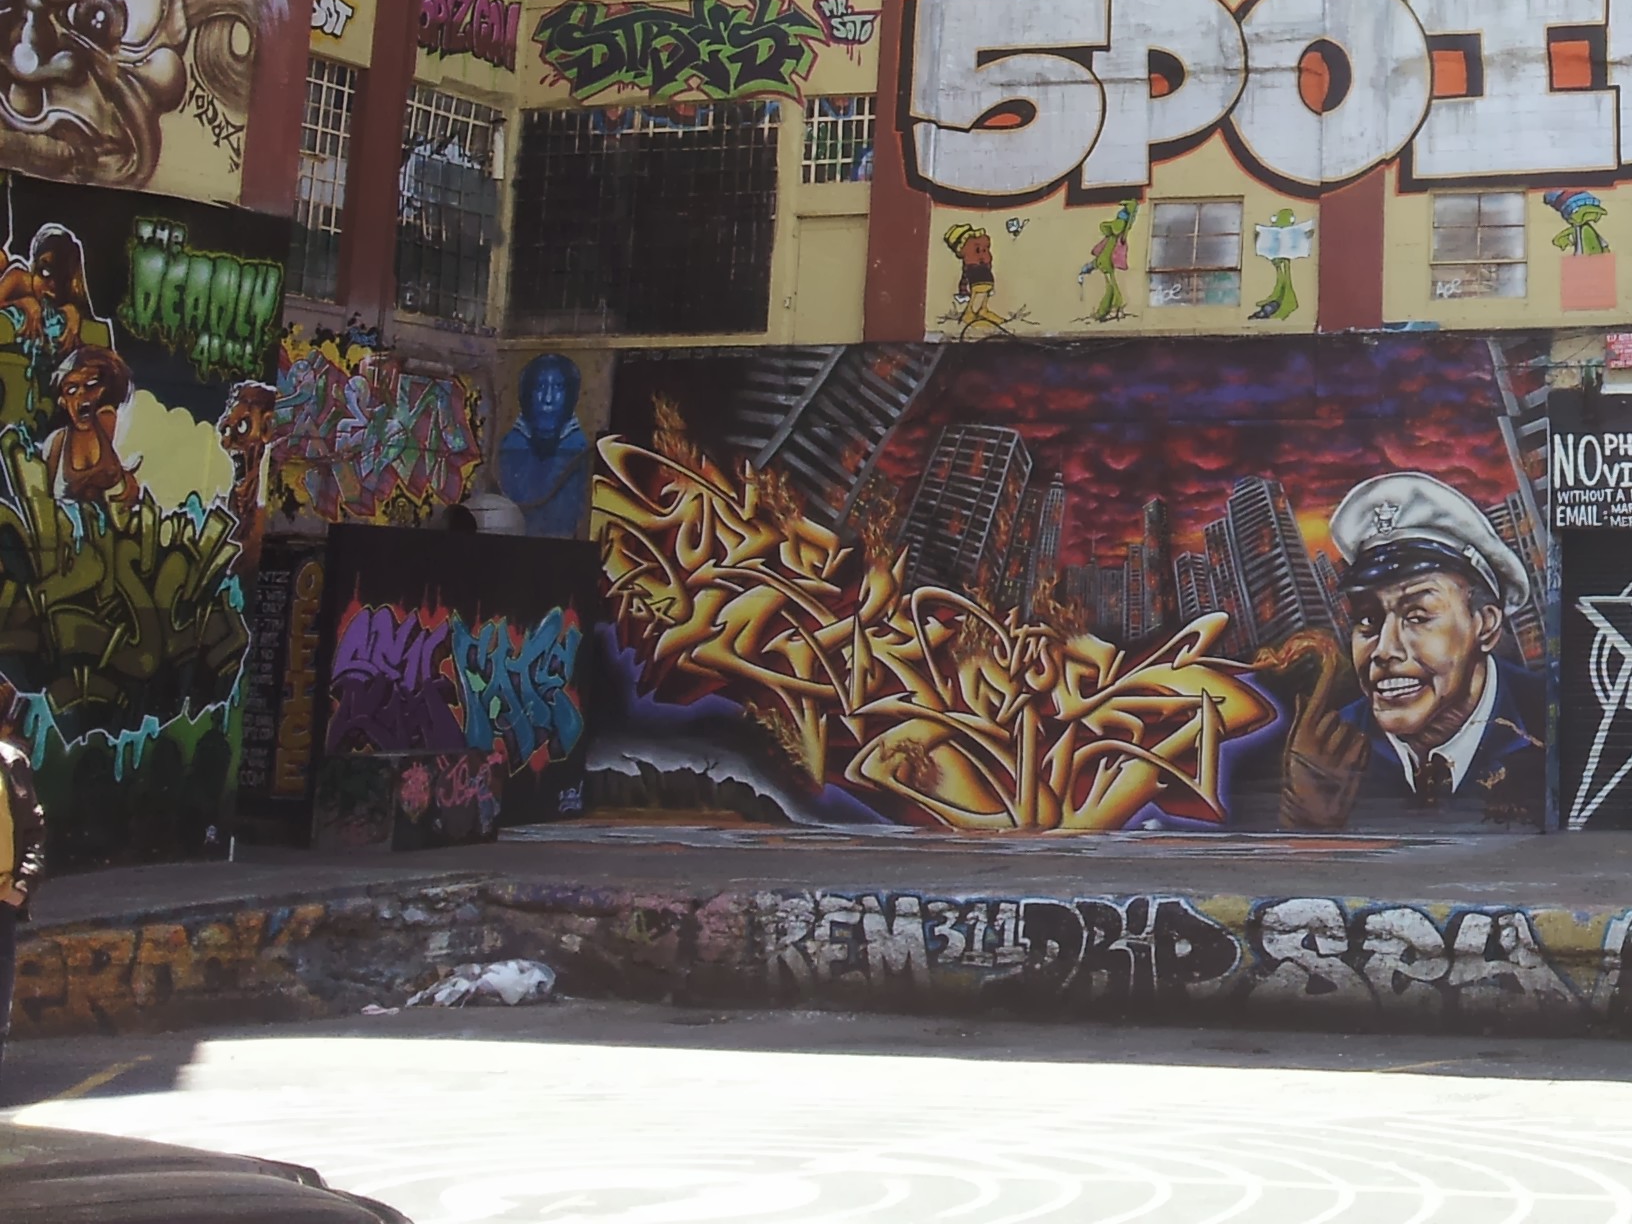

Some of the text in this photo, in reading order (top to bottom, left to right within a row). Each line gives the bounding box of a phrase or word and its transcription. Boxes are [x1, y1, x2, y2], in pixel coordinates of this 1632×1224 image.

[1553, 434, 1602, 488] NO
[1557, 488, 1614, 504] WITHOUT
[1616, 488, 1626, 503] A
[273, 561, 325, 795] OFFICE
